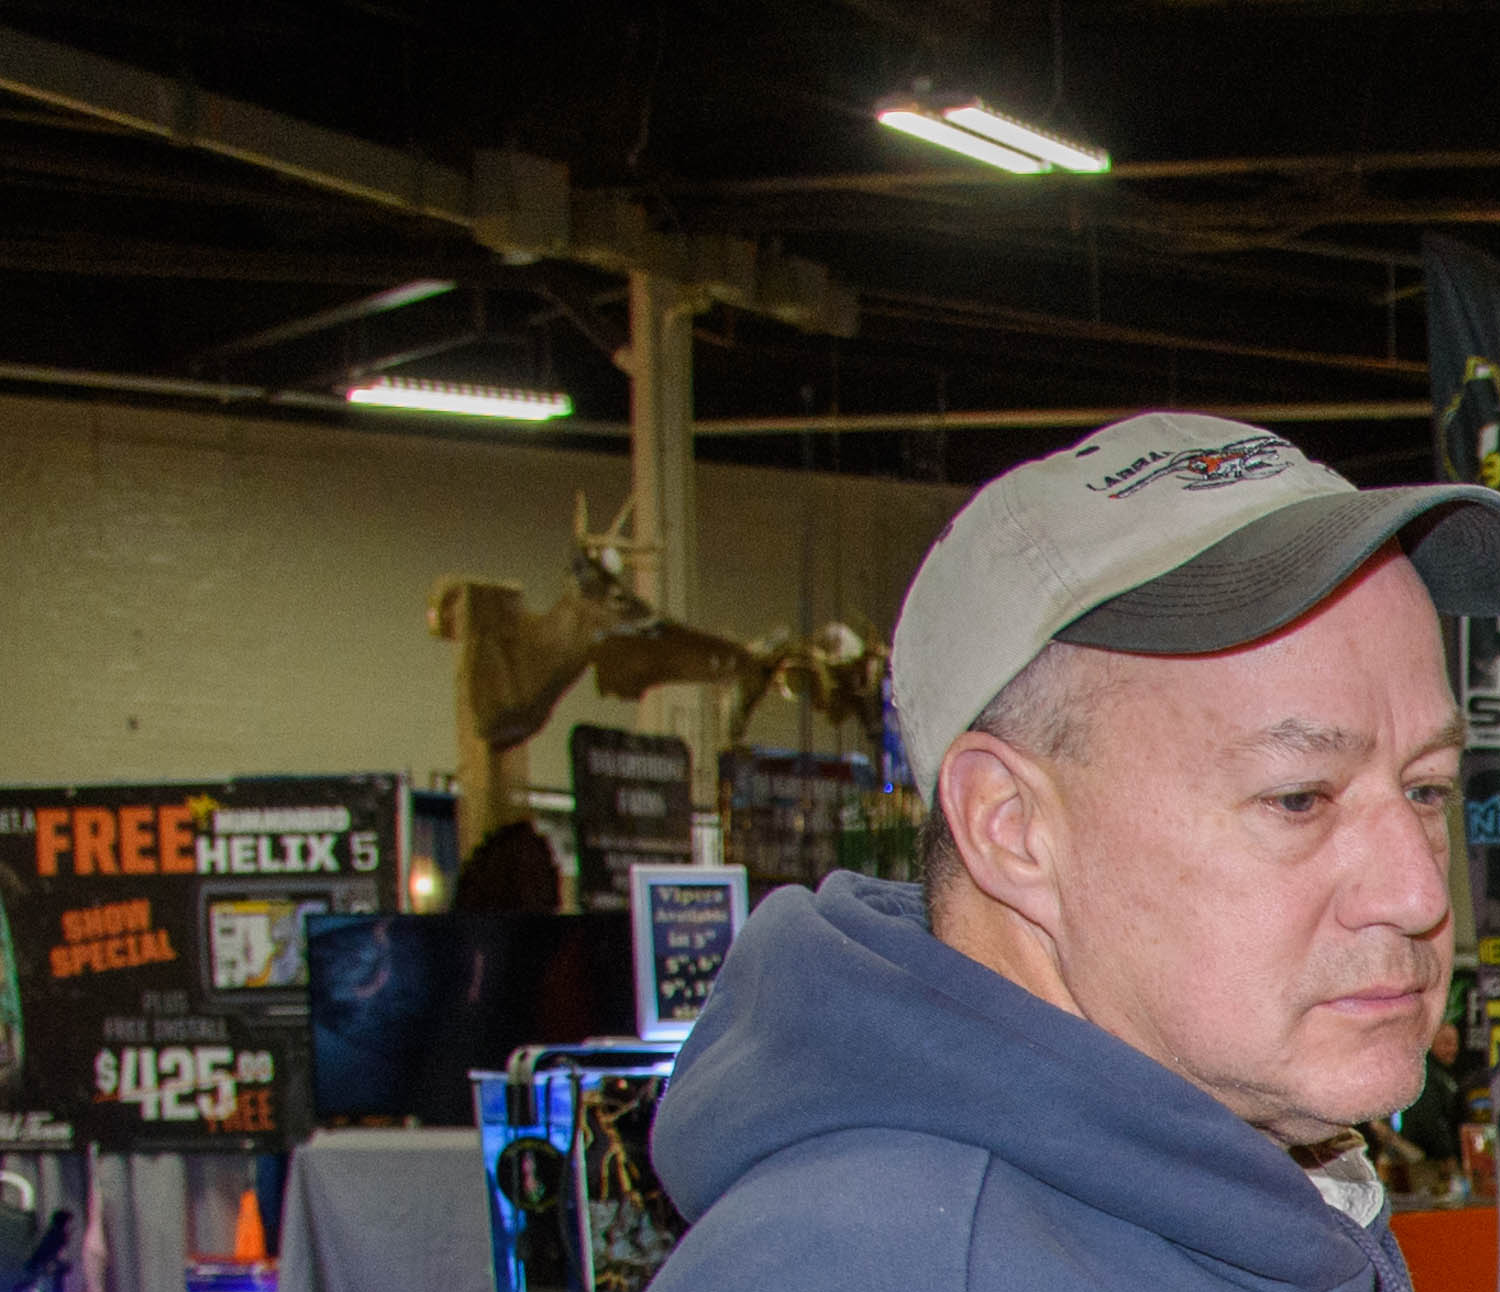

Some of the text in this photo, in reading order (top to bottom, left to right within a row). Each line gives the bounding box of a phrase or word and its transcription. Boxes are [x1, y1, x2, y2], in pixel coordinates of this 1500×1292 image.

[36, 806, 197, 877] FREE
[196, 830, 380, 874] HELIX 5
[61, 899, 153, 943] SHOW
[49, 928, 178, 979] SPECIAL
